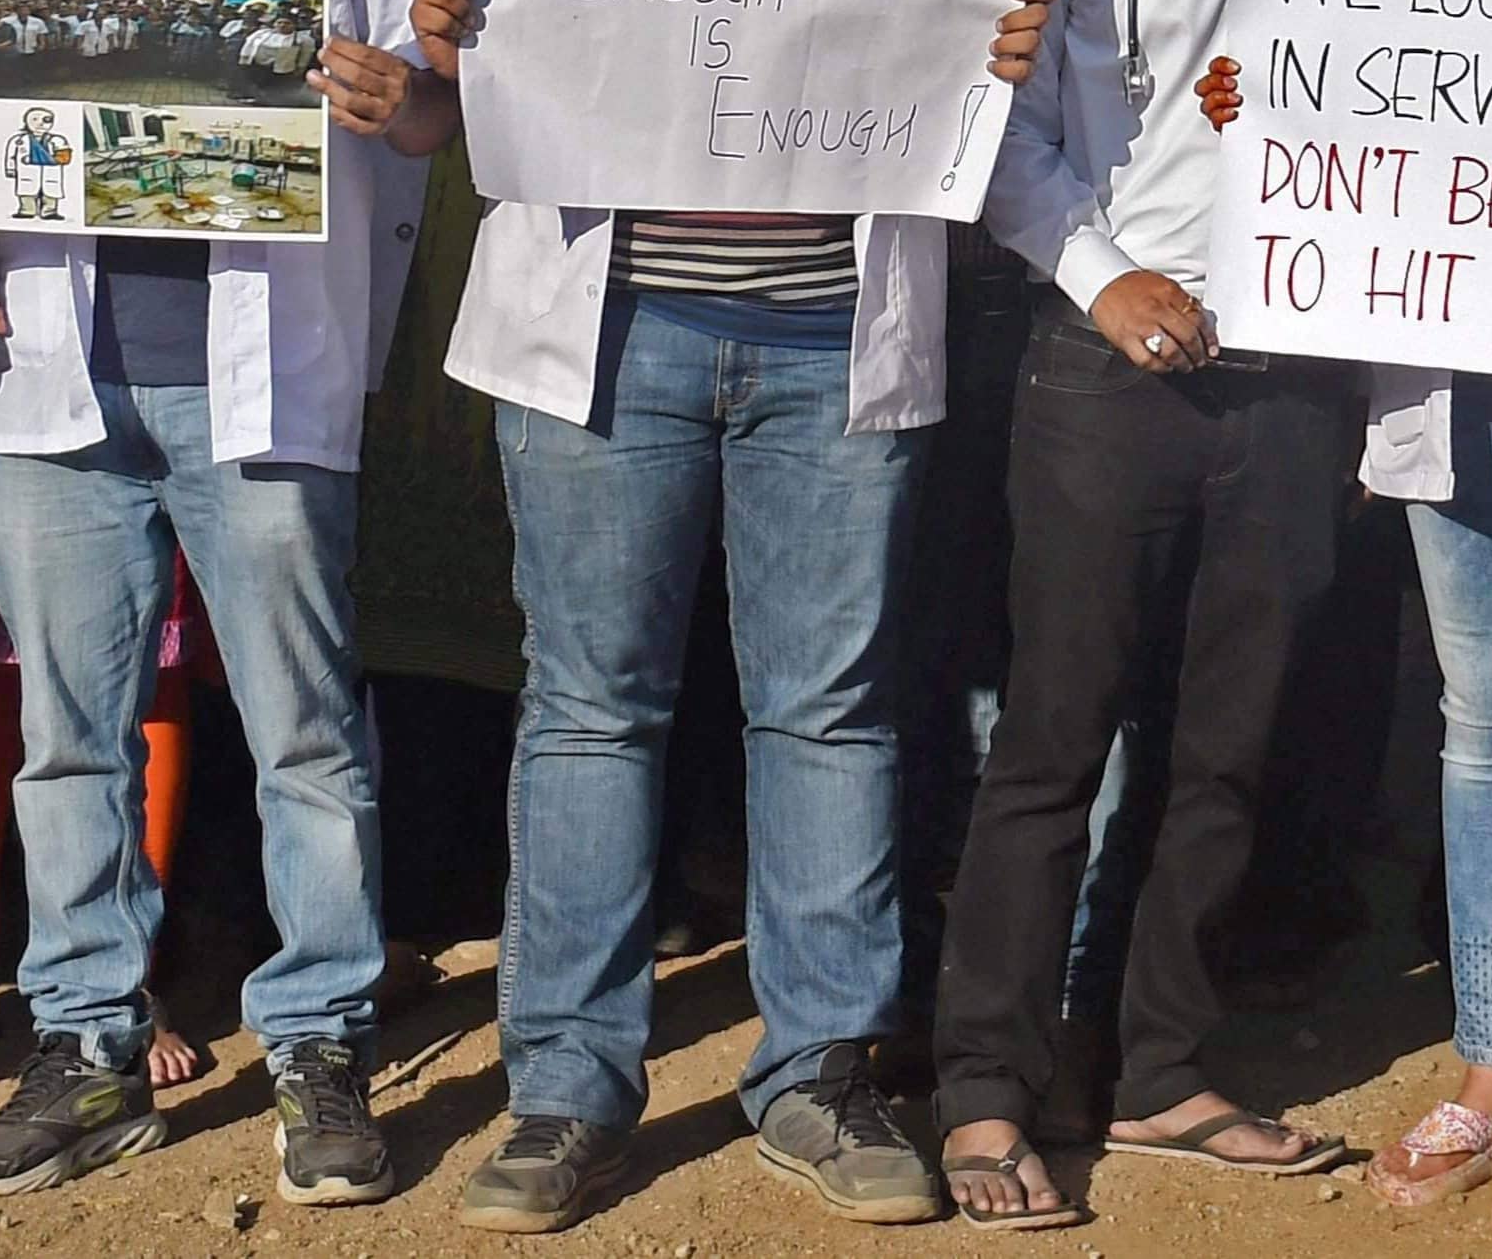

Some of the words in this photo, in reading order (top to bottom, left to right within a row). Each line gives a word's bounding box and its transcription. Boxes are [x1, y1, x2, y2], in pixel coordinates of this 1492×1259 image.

[688, 14, 731, 69] IS
[1268, 38, 1332, 117] IN
[1259, 137, 1420, 219] DON'T
[1255, 233, 1326, 313] TO
[1366, 246, 1477, 323] HIT
